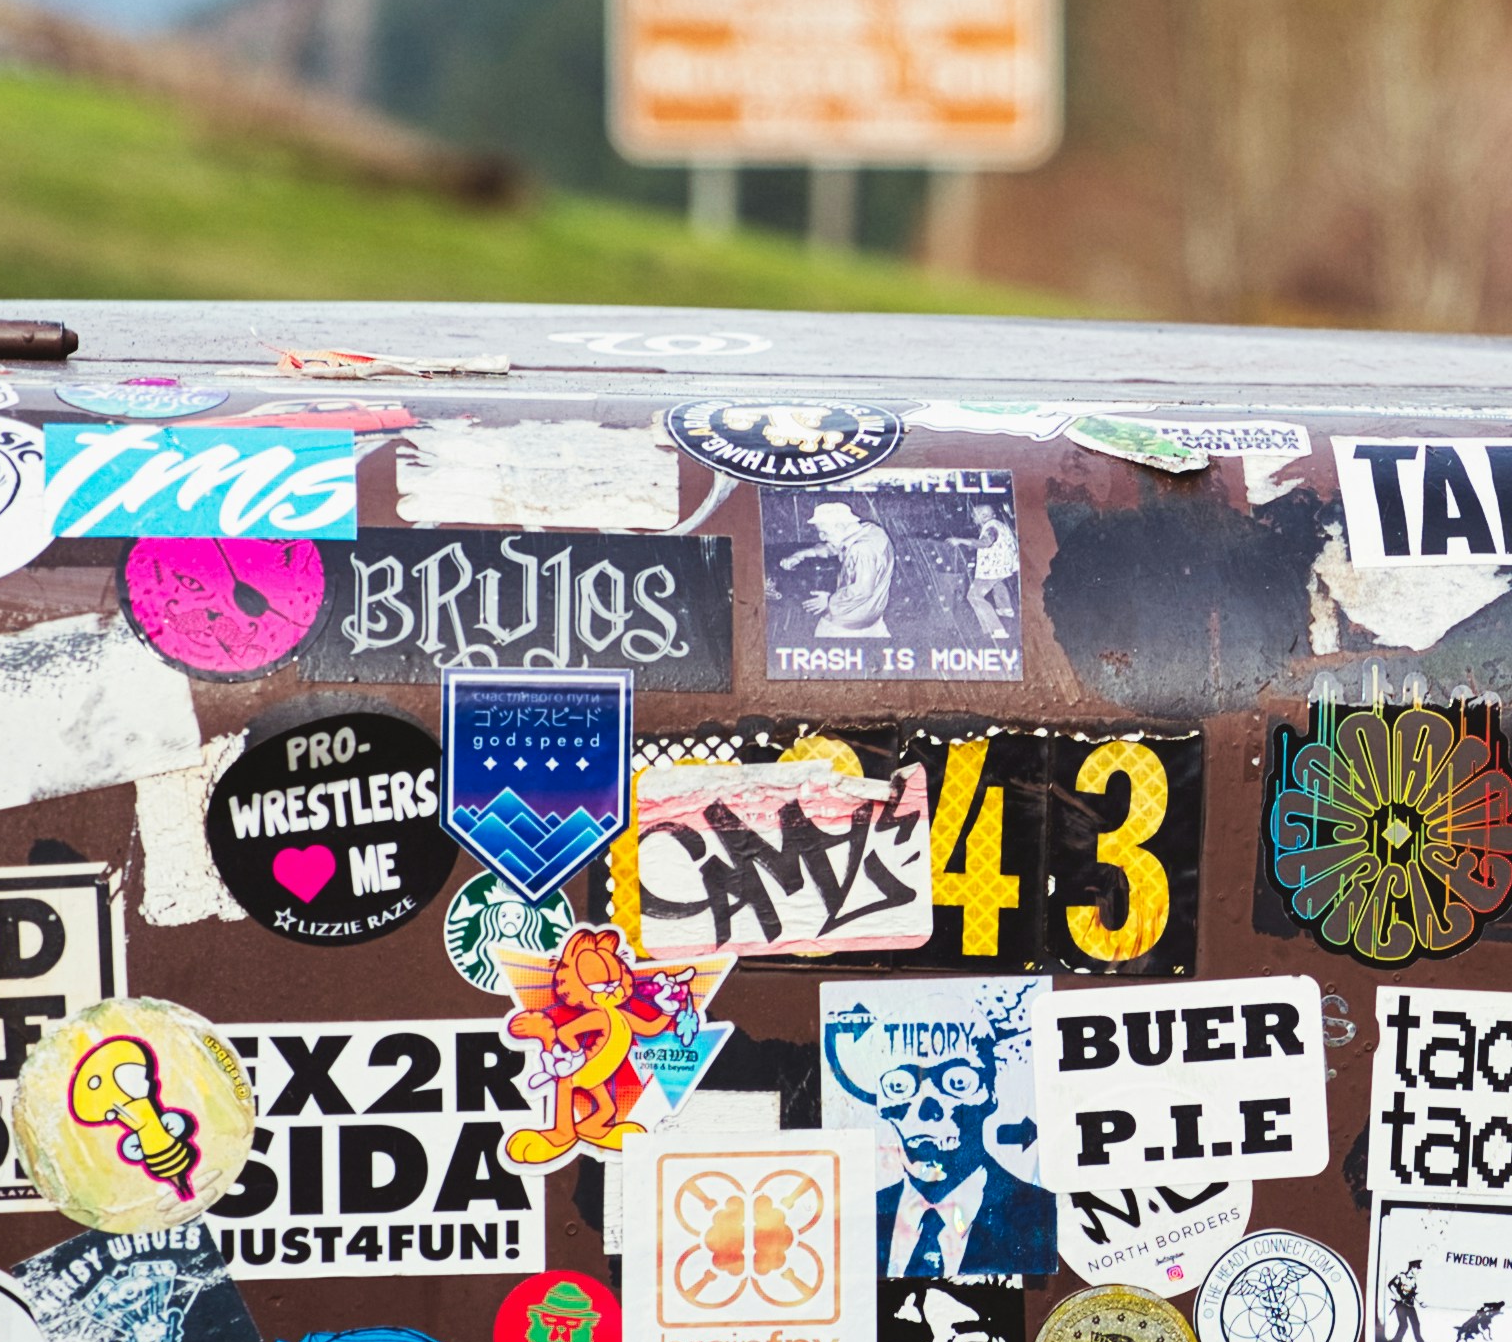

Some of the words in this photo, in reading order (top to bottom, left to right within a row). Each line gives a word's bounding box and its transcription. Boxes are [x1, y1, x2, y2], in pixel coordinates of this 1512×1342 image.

[775, 648, 863, 671] TRASH
[882, 648, 916, 671] IS
[931, 648, 1019, 672] MONEY
[286, 727, 371, 772] PRO-
[472, 732, 600, 750] godspeed
[229, 769, 439, 841] WRESTLERS
[348, 842, 401, 897] ME
[298, 913, 364, 937] LIZZIE
[366, 895, 418, 932] RAZE
[884, 1022, 976, 1057] THEORY
[1057, 1002, 1305, 1072] BUER
[1075, 1097, 1293, 1167] P.I.E
[107, 1226, 202, 1259] WAVES
[1088, 1244, 1150, 1273] NORTH
[1155, 1207, 1241, 1249] BORDERS
[1446, 1251, 1498, 1269] FWEEDOM
[1203, 1288, 1222, 1309] THE
[1217, 1246, 1249, 1287] HEADY
